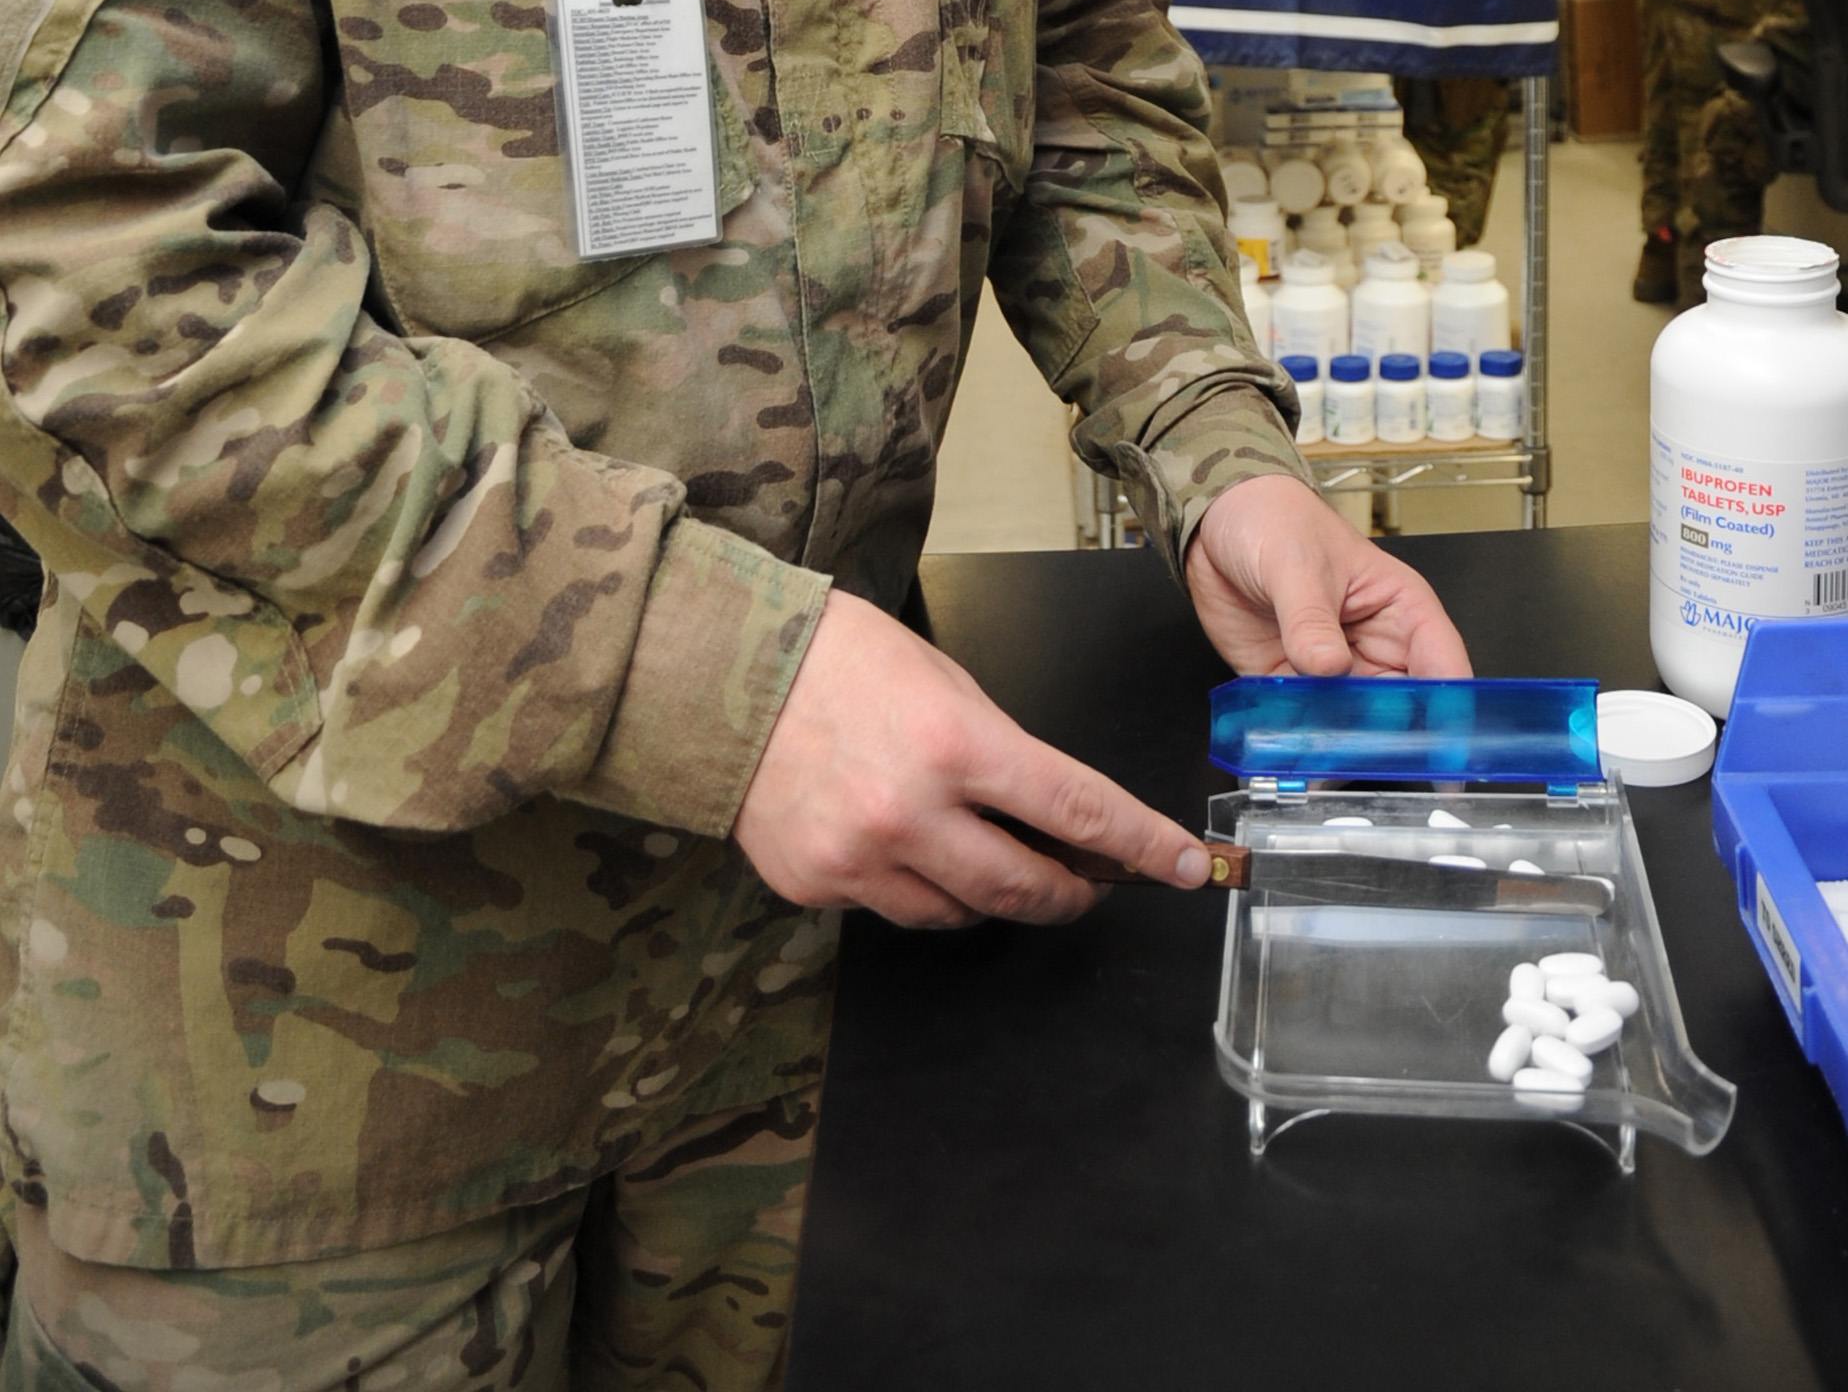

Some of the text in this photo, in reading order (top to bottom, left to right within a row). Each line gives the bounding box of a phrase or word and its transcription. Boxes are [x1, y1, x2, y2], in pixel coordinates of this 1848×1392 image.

[1680, 466, 1773, 497] IBUPROFEN
[1681, 484, 1749, 516] TABLETS,
[1751, 502, 1786, 517] USP
[1680, 504, 1712, 526] (Film
[1715, 516, 1775, 539] Coated)
[1682, 526, 1707, 546] 800
[1710, 538, 1733, 556] mg
[1804, 538, 1825, 548] KEEP
[1827, 536, 1844, 546] THIS
[1696, 558, 1738, 577] MEDICATION
[1739, 569, 1764, 581] GUIDE
[1745, 563, 1779, 574] DISPENSE
[1804, 556, 1846, 569] REACH OF
